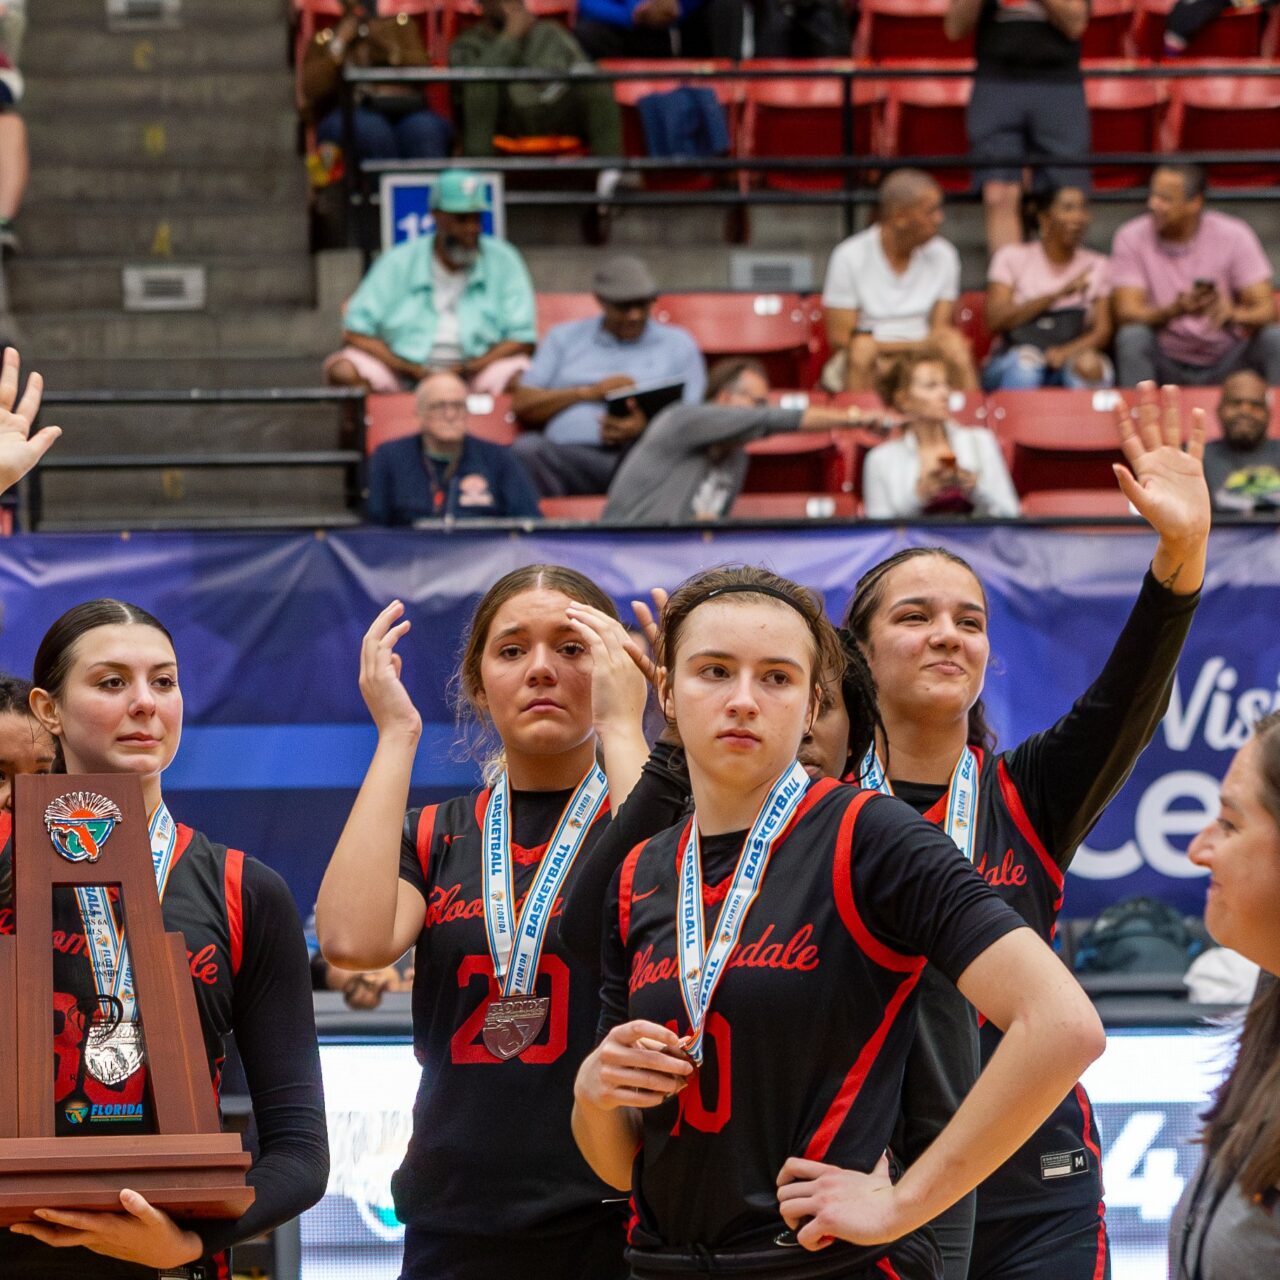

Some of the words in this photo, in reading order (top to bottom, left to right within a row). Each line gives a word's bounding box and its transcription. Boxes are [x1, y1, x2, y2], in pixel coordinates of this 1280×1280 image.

[1161, 655, 1280, 750] Vis
[574, 793, 592, 818] FLORIDA
[957, 789, 967, 818] FLORIDA
[490, 793, 503, 876] BASKETBALL
[742, 777, 801, 881] BASKETBALL
[524, 842, 571, 940] BASKETBALL
[683, 842, 696, 949] BASKETBALL
[495, 903, 507, 935] FLORIDA
[724, 894, 743, 929] FLORIDA
[514, 951, 528, 989] FLORIDA
[451, 953, 570, 1065] 20
[90, 1103, 144, 1116] FLORIDA
[1075, 1155, 1084, 1168] M
